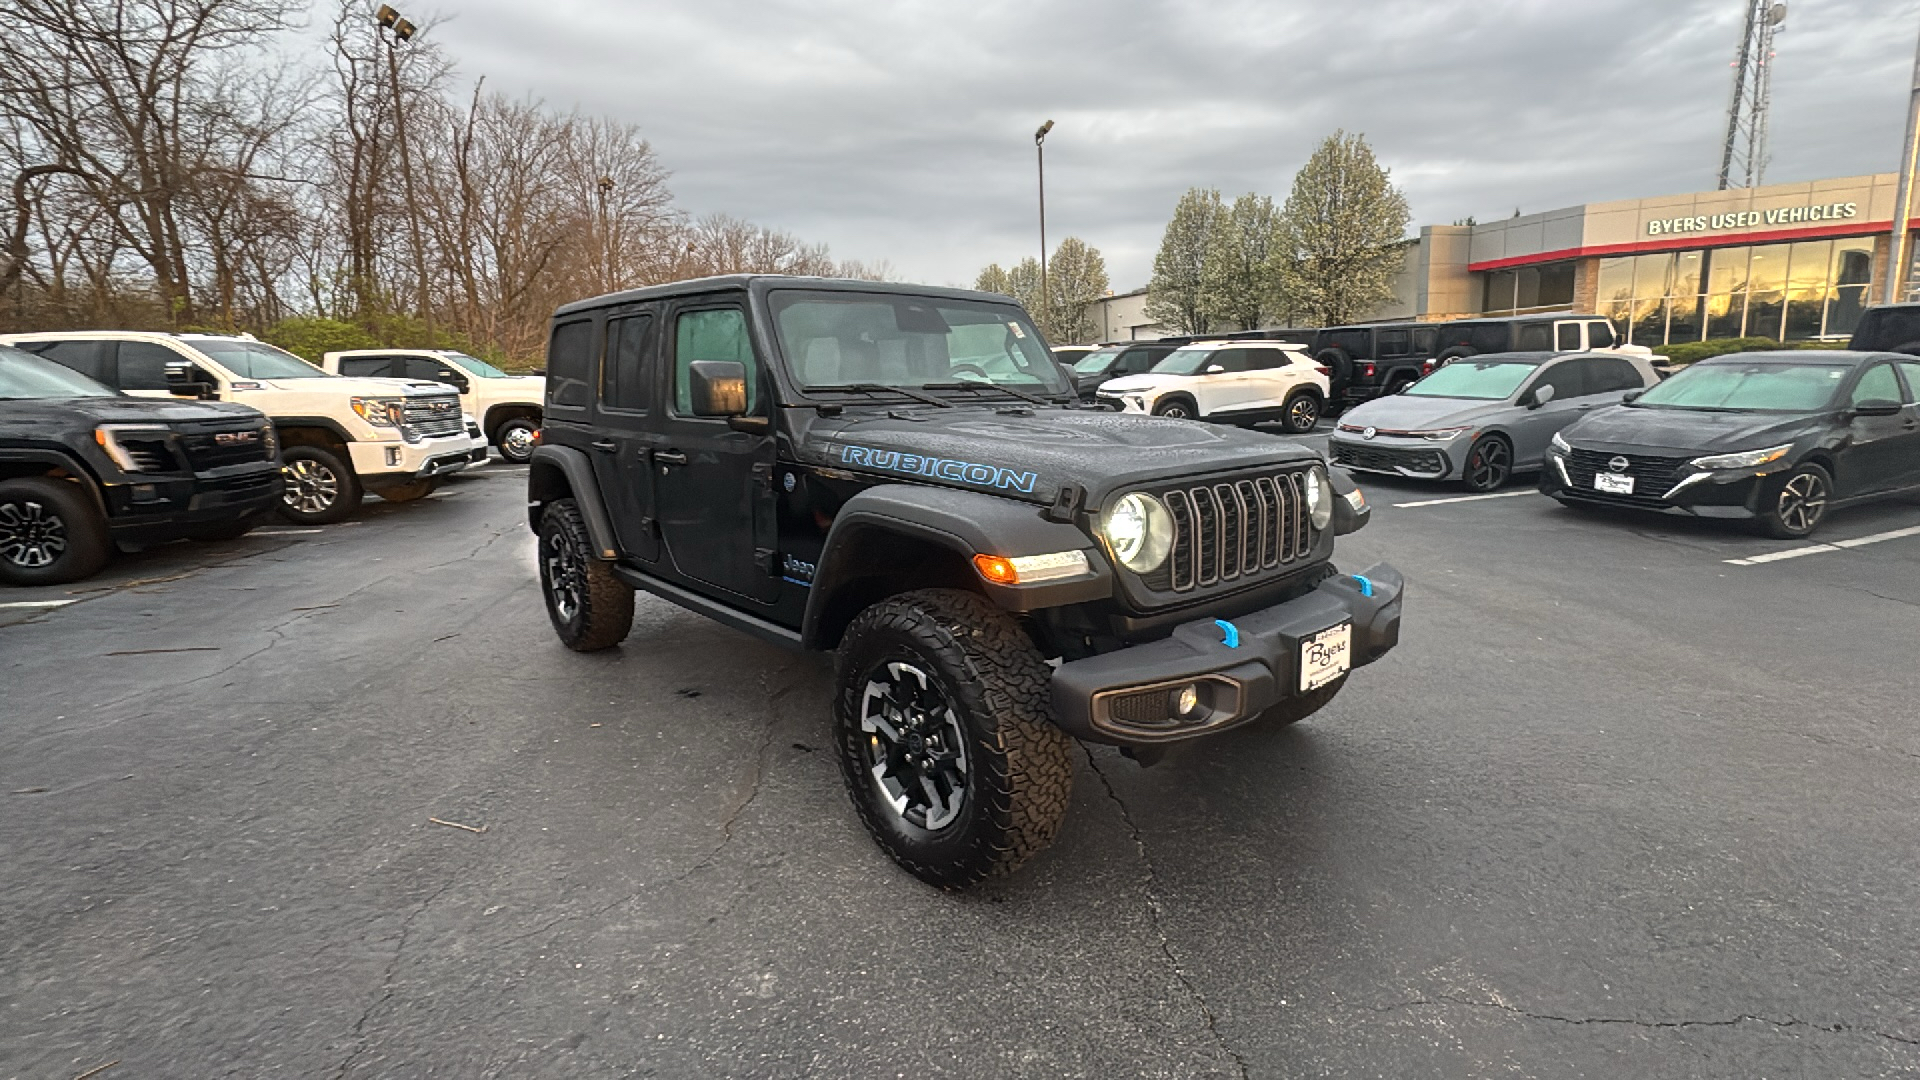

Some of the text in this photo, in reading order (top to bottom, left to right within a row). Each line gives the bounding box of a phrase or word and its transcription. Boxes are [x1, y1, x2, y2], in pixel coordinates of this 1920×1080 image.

[1648, 202, 1857, 235] BYERS USED VEHICLES
[842, 445, 1038, 493] RUBICON
[783, 553, 815, 580] Jeep
[1306, 640, 1346, 667] Byers
